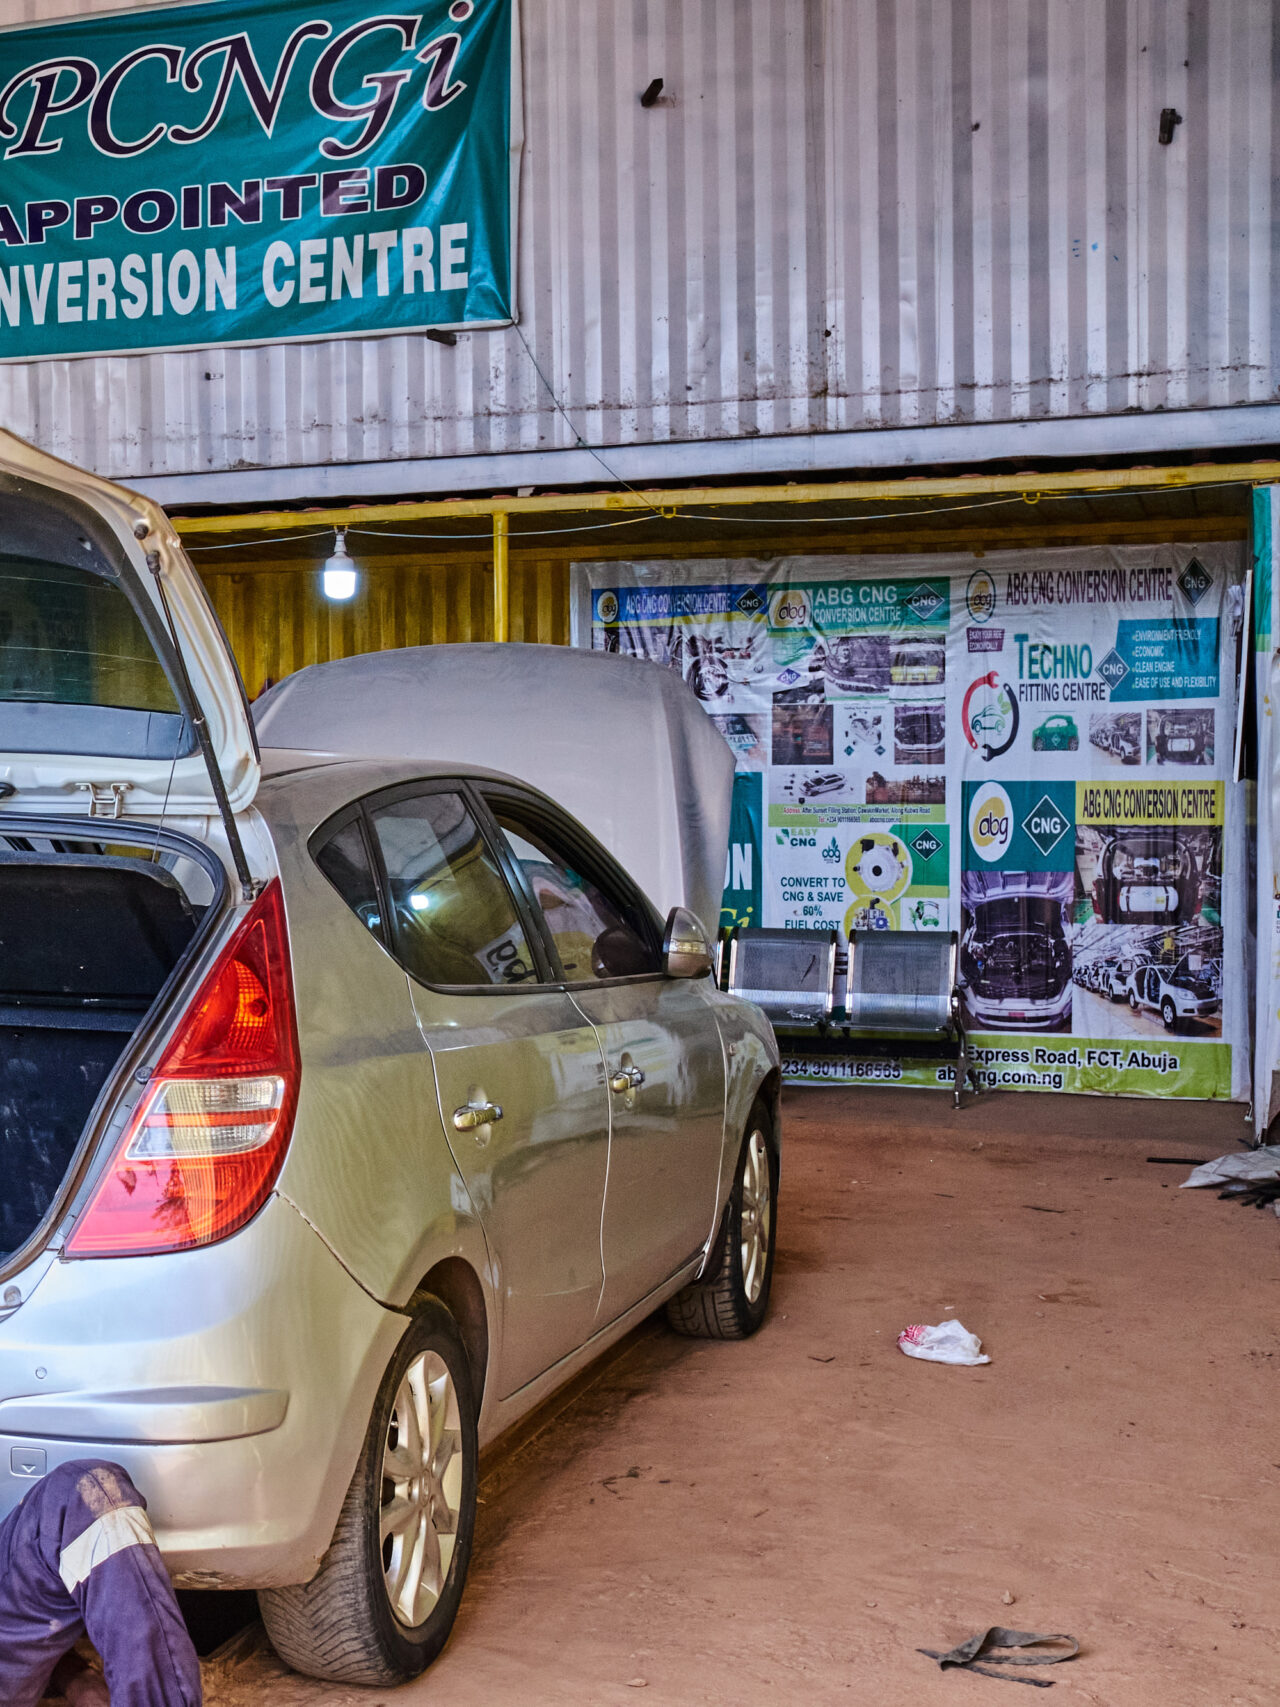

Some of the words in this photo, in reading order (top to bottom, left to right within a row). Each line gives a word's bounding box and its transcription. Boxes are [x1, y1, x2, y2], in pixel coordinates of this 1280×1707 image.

[262, 223, 469, 309] CENTRE
[1006, 573, 1029, 605] ABG
[1031, 572, 1054, 604] CNG
[1056, 570, 1126, 603] CONVERSION
[1129, 568, 1172, 600] CENTRE
[1184, 576, 1206, 589] CNG
[815, 588, 854, 606] ABG
[860, 586, 898, 603] CNG
[911, 594, 937, 607] CNG
[740, 599, 759, 608] CNG
[778, 604, 807, 627] abg
[814, 607, 867, 624] CONVERSION
[869, 606, 901, 622] CENTRE
[1135, 646, 1164, 657] ECONOMIC
[1102, 664, 1124, 677] CNG
[1135, 661, 1154, 672] CLEAN
[1155, 661, 1175, 672] ENGINE
[1135, 677, 1150, 688] EASE
[1150, 677, 1159, 688] OF
[1160, 677, 1171, 688] USE
[1171, 676, 1183, 687] AND
[1184, 675, 1217, 688] FLEXIBILITY
[1019, 684, 1059, 701] FITTING
[1062, 682, 1106, 701] CENTRE
[1083, 789, 1101, 818] ABG
[1103, 789, 1122, 818] CNG
[1123, 789, 1178, 818] CONVERSION
[1180, 789, 1215, 818] CENTRE
[979, 812, 1008, 844] abg
[1031, 817, 1061, 834] CNG
[790, 838, 816, 847] CNG
[916, 840, 937, 850] CNG
[780, 877, 829, 888] CONVERT
[832, 877, 846, 888] TO
[782, 891, 806, 902] CNG
[807, 892, 815, 902] &
[817, 891, 844, 902] SAVE
[802, 906, 823, 916] 60%
[785, 920, 810, 930] FUEL
[813, 920, 841, 930] COST
[1035, 1049, 1081, 1067] Road,
[1088, 1051, 1124, 1069] FCT,
[1128, 1052, 1177, 1072] Abuja
[937, 1066, 1063, 1088] abng.com.ng
